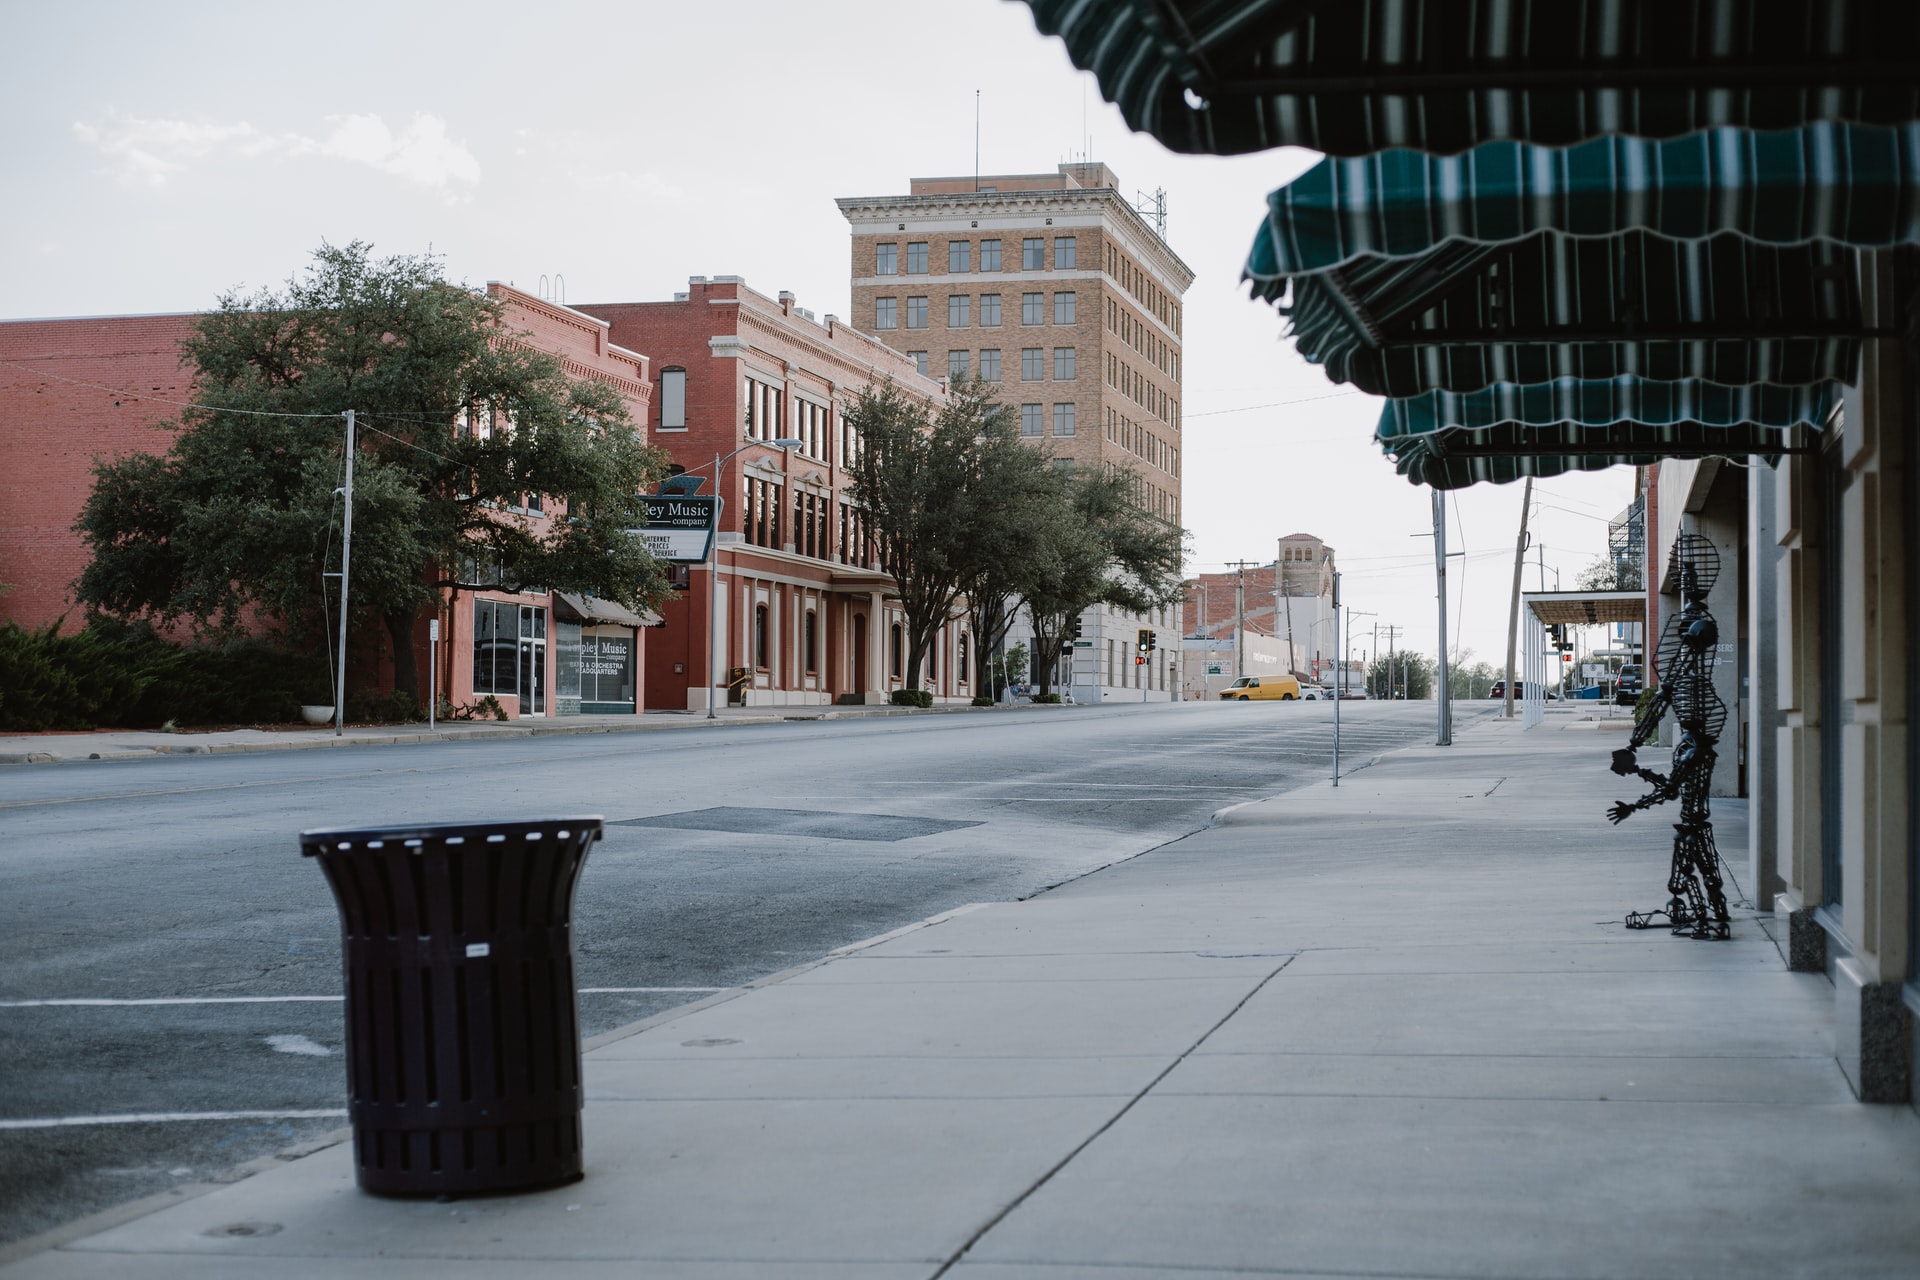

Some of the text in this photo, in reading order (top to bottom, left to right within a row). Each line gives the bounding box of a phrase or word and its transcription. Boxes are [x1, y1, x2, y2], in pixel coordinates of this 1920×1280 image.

[668, 502, 709, 516] Music
[672, 518, 707, 527] company
[602, 642, 627, 654] Music
[1716, 644, 1733, 652] SERS
